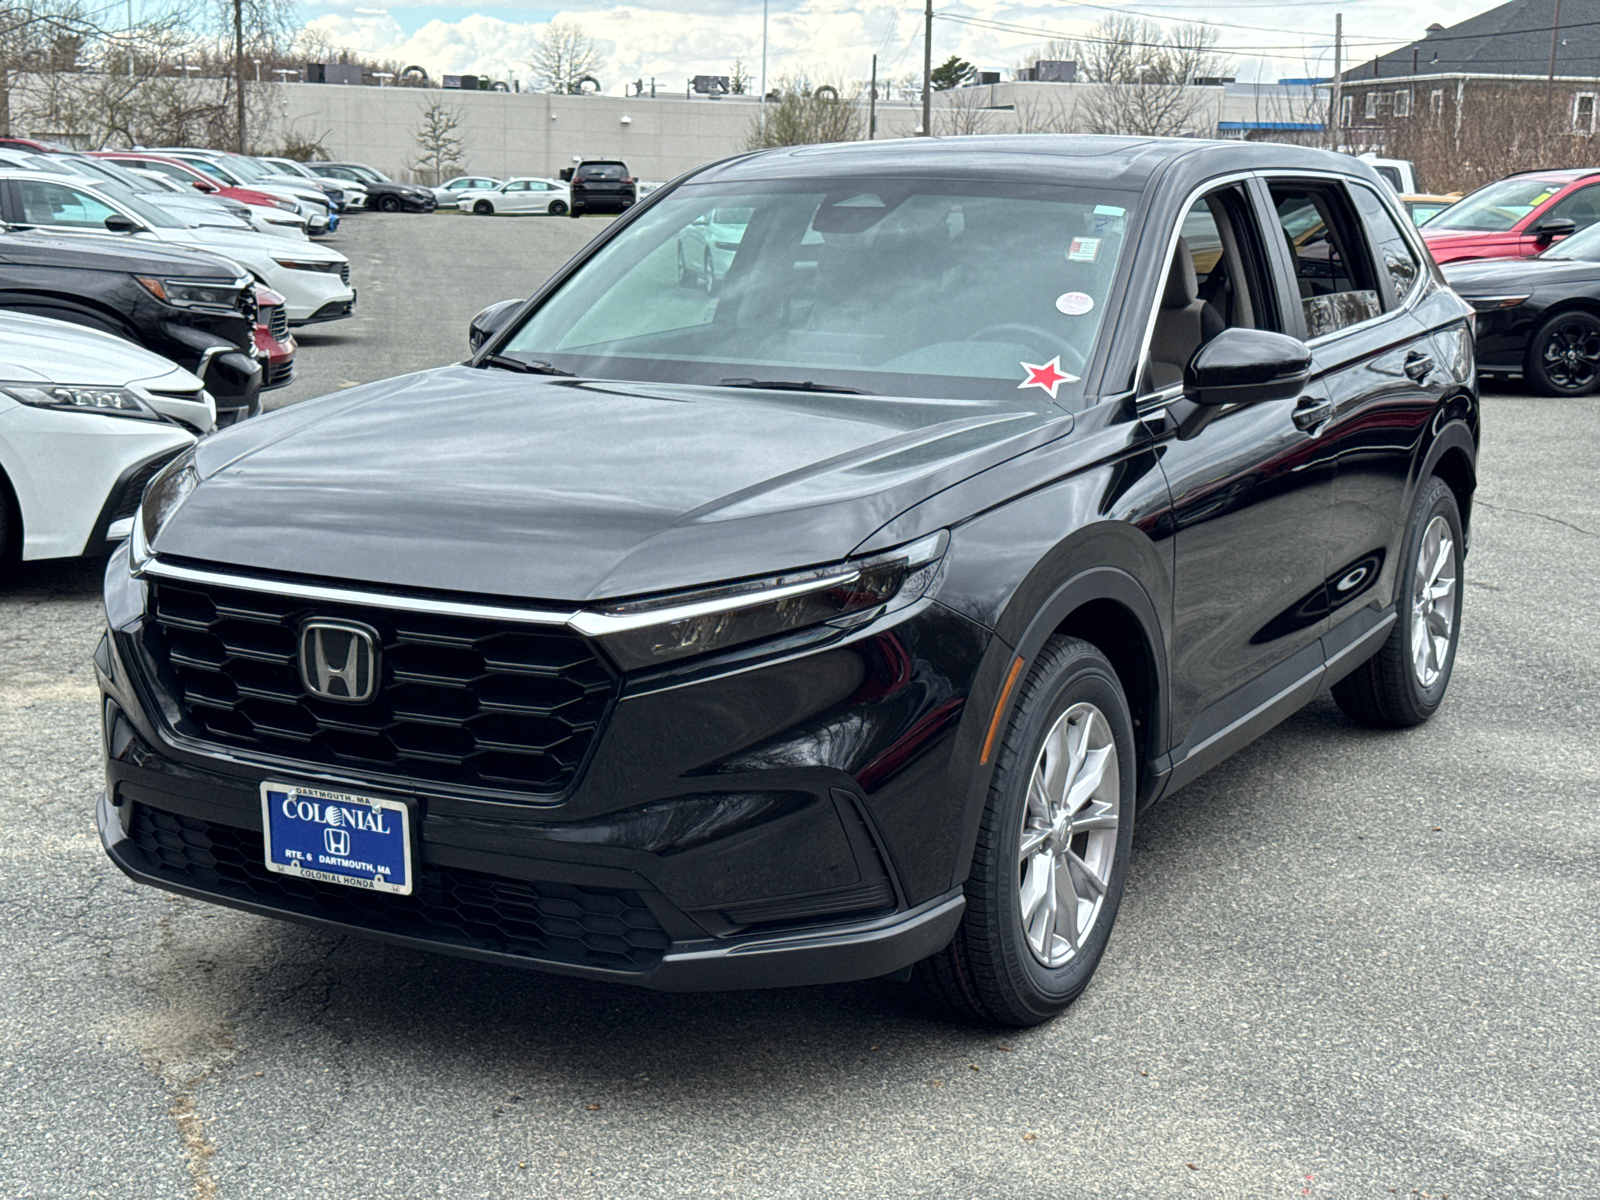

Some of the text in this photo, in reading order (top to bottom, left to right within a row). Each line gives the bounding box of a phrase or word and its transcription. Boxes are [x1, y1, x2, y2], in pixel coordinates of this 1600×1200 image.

[282, 799, 391, 834] COLONIAL
[285, 849, 391, 875] RTE. 6 DARTMOUTH, MA
[300, 869, 375, 889] COLONIAL HONDA
